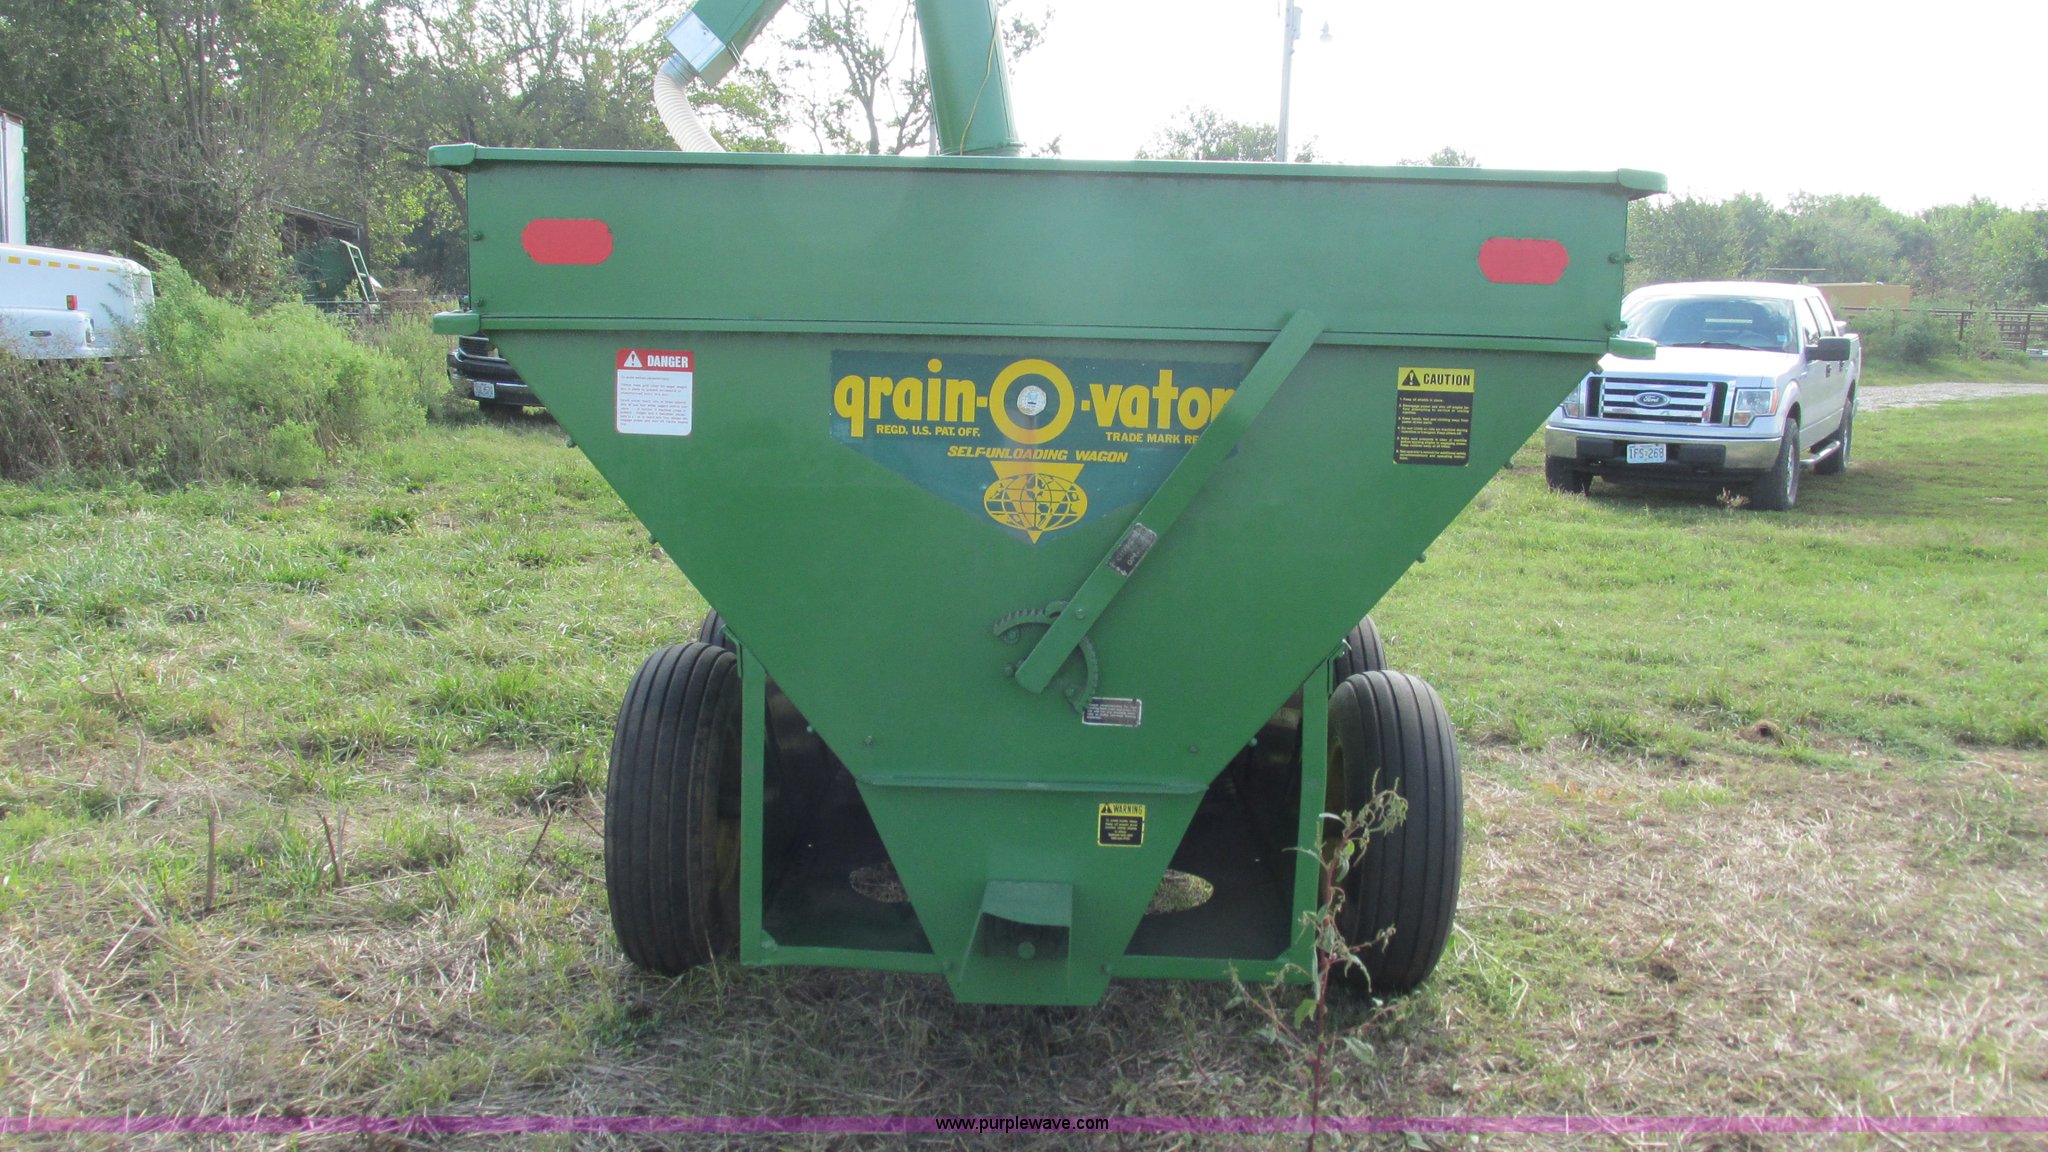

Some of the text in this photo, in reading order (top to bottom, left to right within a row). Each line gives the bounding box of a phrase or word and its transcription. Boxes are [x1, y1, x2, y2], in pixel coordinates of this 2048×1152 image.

[647, 354, 689, 368] DANGER
[1423, 372, 1470, 386] CAUTION
[876, 424, 981, 437] REGD. U.S. PAT. OFF.
[1105, 431, 1143, 443] TRADE
[1147, 433, 1180, 444] MARK
[947, 445, 1128, 463] SELF-UNLOADING WAGON
[1113, 803, 1143, 815] WARNING
